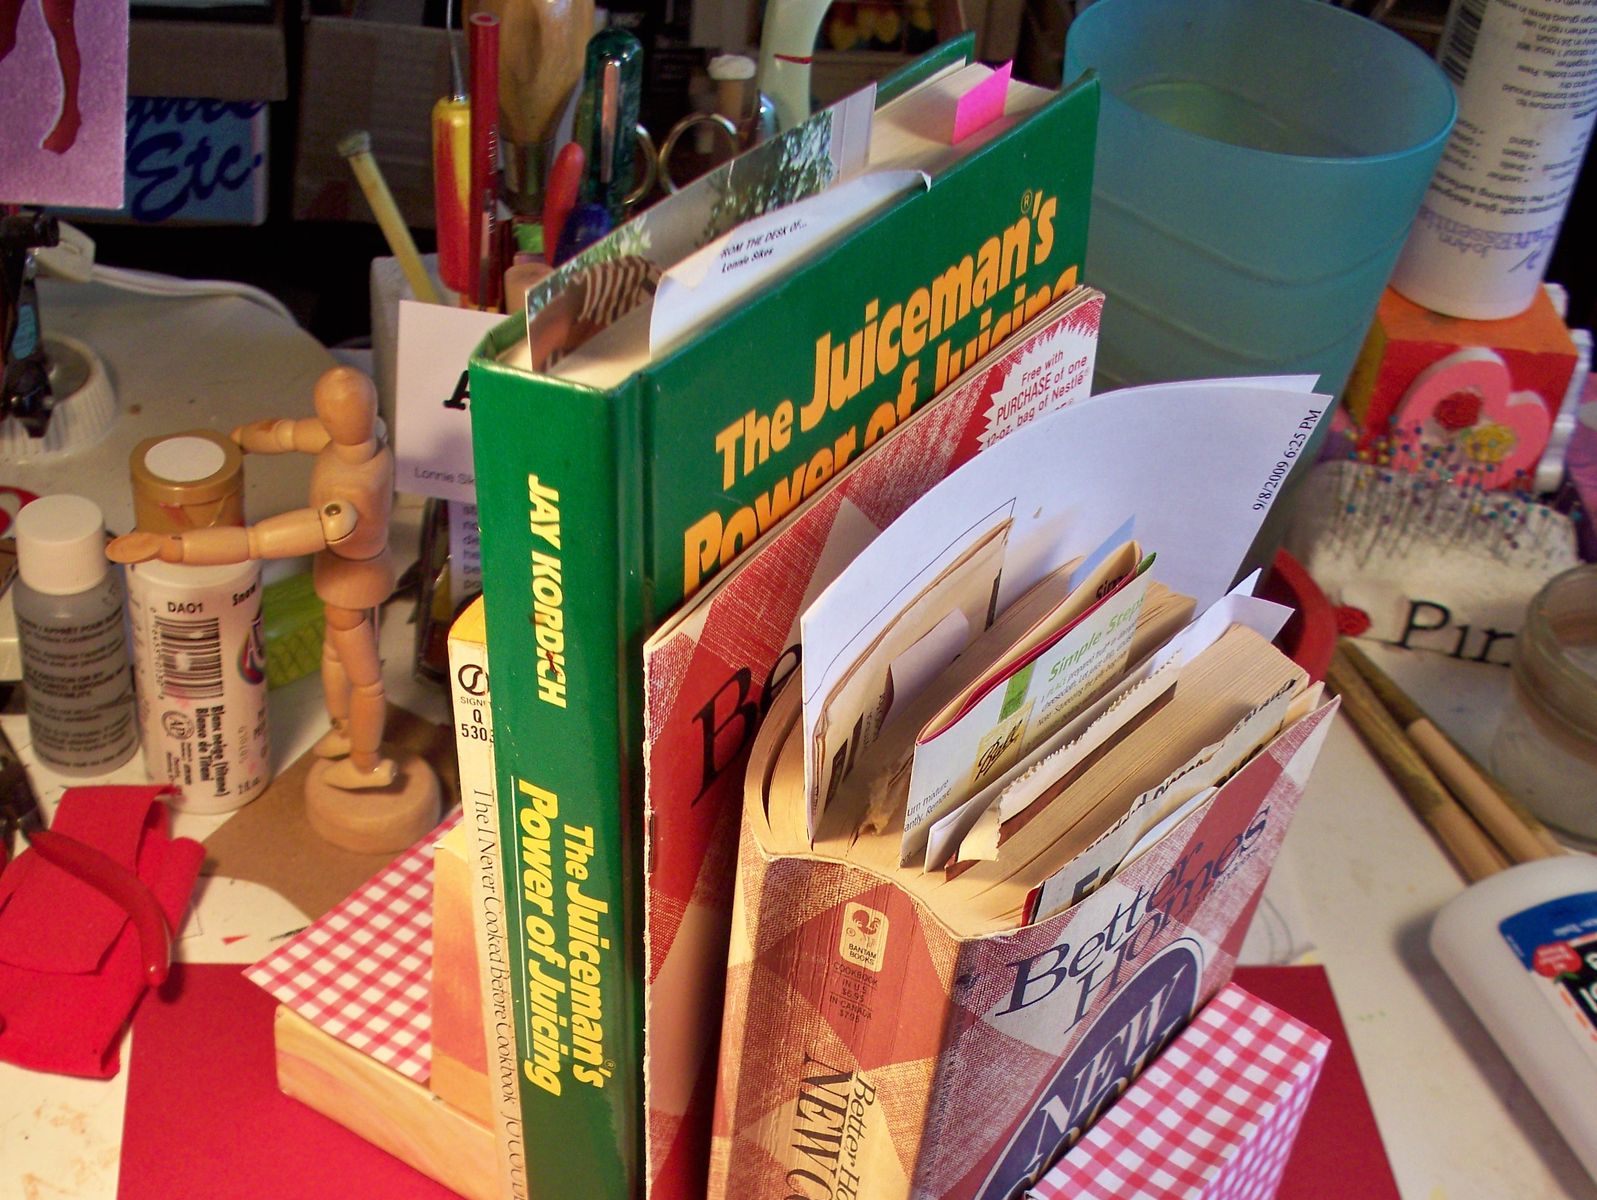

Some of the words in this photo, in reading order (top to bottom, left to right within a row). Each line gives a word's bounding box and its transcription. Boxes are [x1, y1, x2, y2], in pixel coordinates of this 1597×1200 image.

[126, 131, 262, 223] Etc.
[996, 372, 1052, 426] PURCHASE
[1053, 368, 1065, 384] of
[1068, 355, 1088, 375] one
[1021, 364, 1042, 387] Free
[1044, 350, 1064, 372] with
[716, 400, 793, 491] The
[1016, 407, 1035, 428] bag
[1038, 394, 1049, 412] of
[1252, 461, 1289, 511] 9/8/2009
[1283, 432, 1307, 459] 6:25
[1299, 409, 1322, 430] PM
[527, 473, 562, 550] JAY
[531, 551, 568, 710] KORDICH
[1046, 630, 1104, 683] Simple
[459, 697, 491, 707] SIGN
[472, 708, 483, 725] Q
[474, 788, 495, 826] The
[478, 837, 498, 893] Never
[518, 777, 560, 917] Power
[563, 823, 595, 881] The
[483, 893, 505, 964] Cooked
[525, 914, 567, 964] of
[848, 943, 877, 960] BANTAM
[995, 841, 1204, 1018] Better
[1063, 805, 1272, 1036] Homes
[489, 965, 511, 1021] Before
[849, 951, 875, 966] BOOKS
[496, 1020, 518, 1105] Cookbook
[523, 961, 569, 1097] Juicing
[791, 1051, 854, 1179] NEW
[845, 1076, 877, 1168] Better
